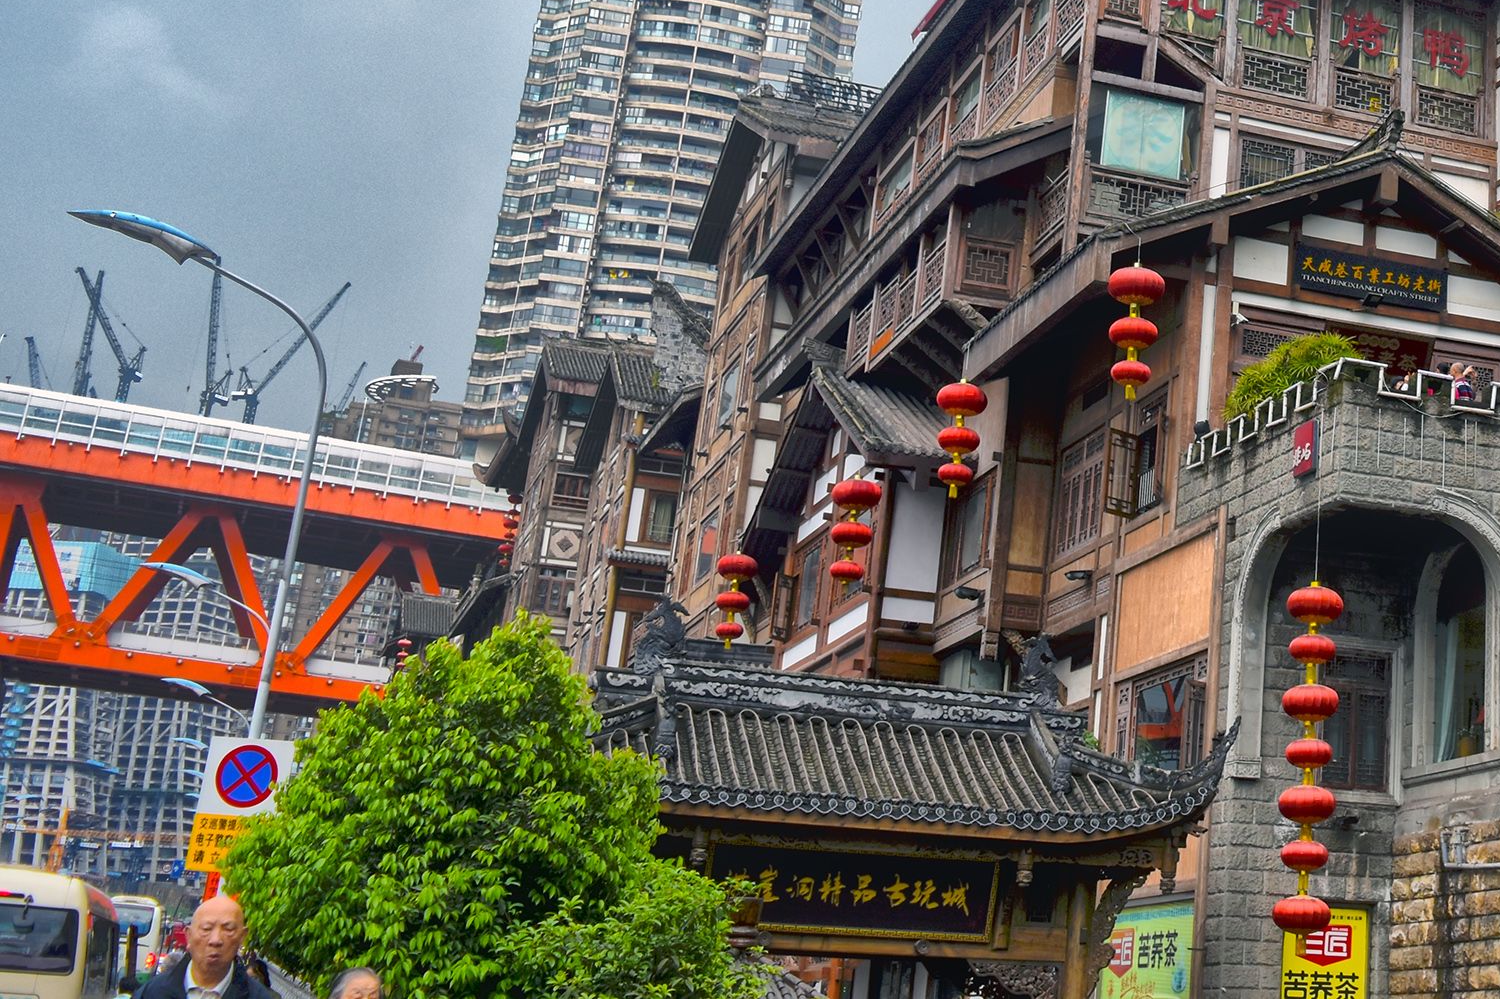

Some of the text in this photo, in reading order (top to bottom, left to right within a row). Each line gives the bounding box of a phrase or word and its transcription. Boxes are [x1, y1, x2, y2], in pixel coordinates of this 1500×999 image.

[1409, 293, 1440, 303] STREET
[1138, 929, 1178, 969] 苦荞茶
[1284, 970, 1359, 999] 苦荞茶
